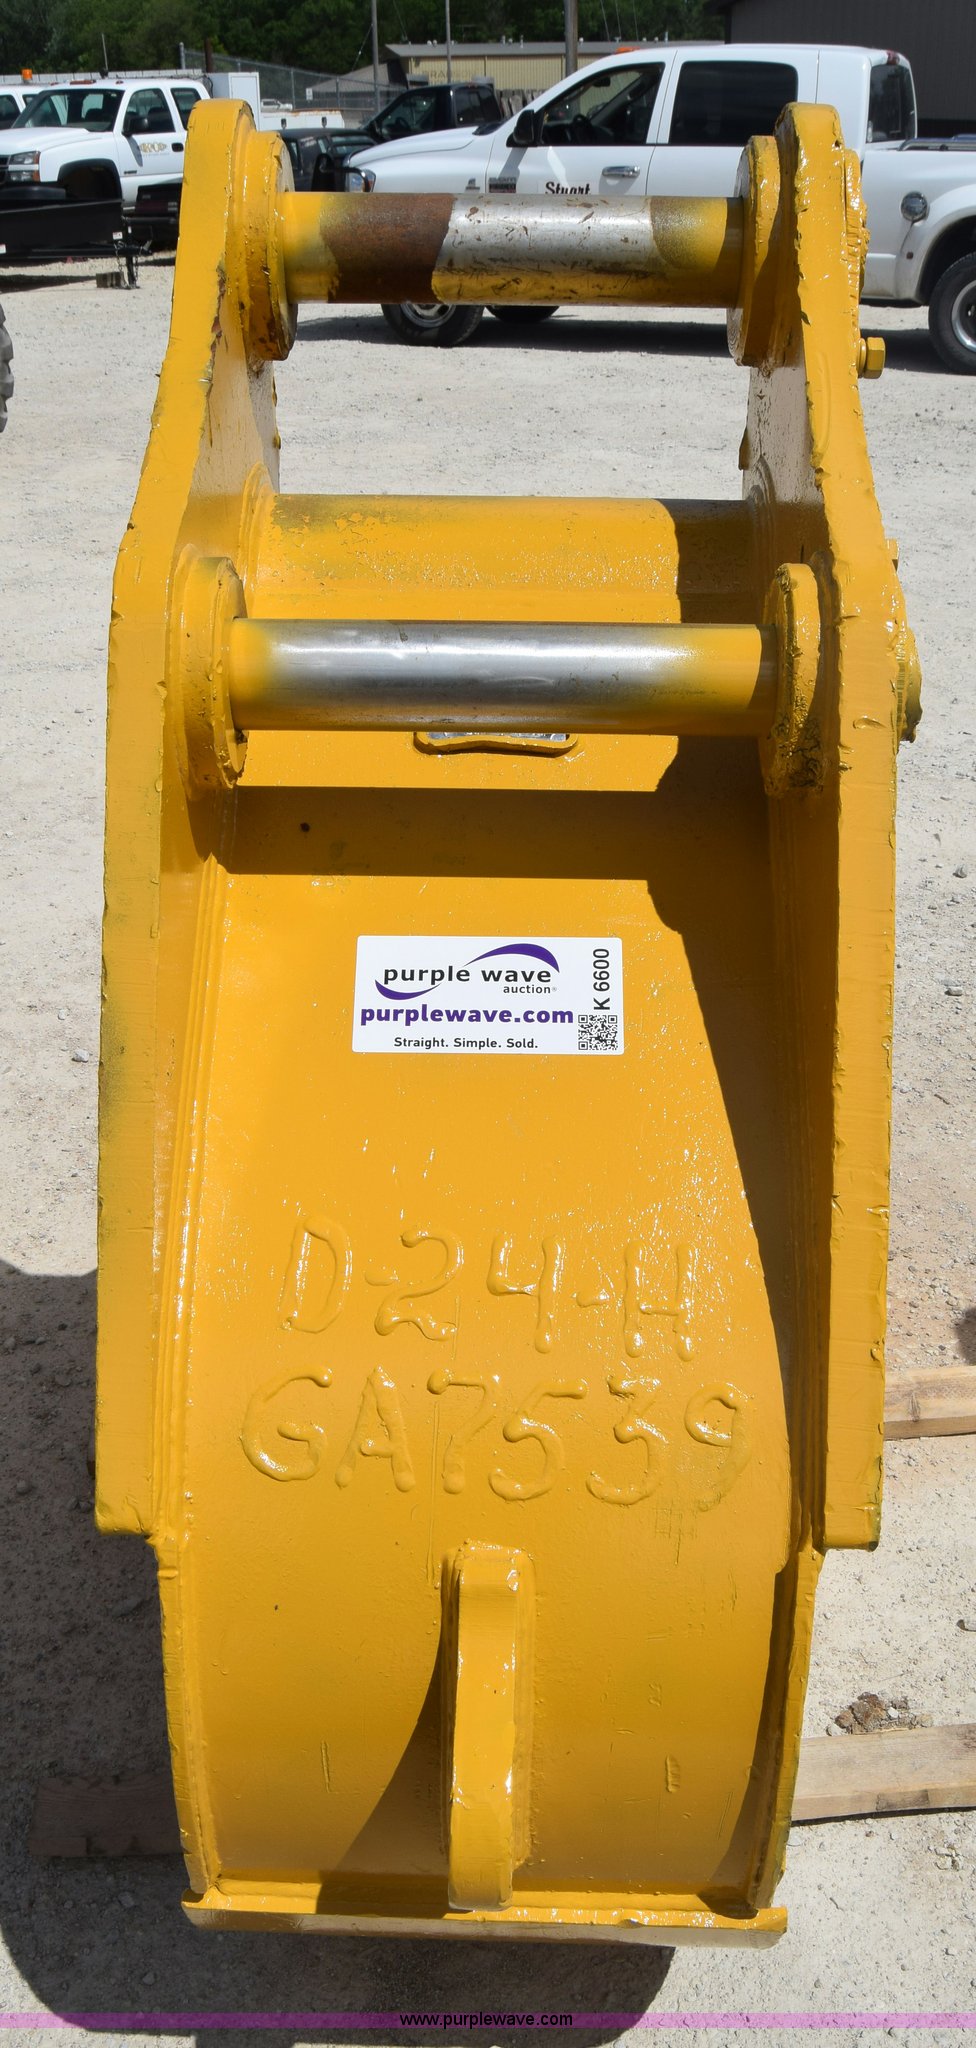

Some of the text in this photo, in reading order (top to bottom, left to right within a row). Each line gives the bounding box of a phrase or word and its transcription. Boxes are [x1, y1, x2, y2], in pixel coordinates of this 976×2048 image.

[384, 965, 552, 985] purple wave
[593, 948, 611, 1011] K 6600
[360, 1003, 574, 1026] purplewave.com
[394, 1036, 538, 1050] Straight. Simple. Sold.
[241, 1366, 754, 1511] GA7539
